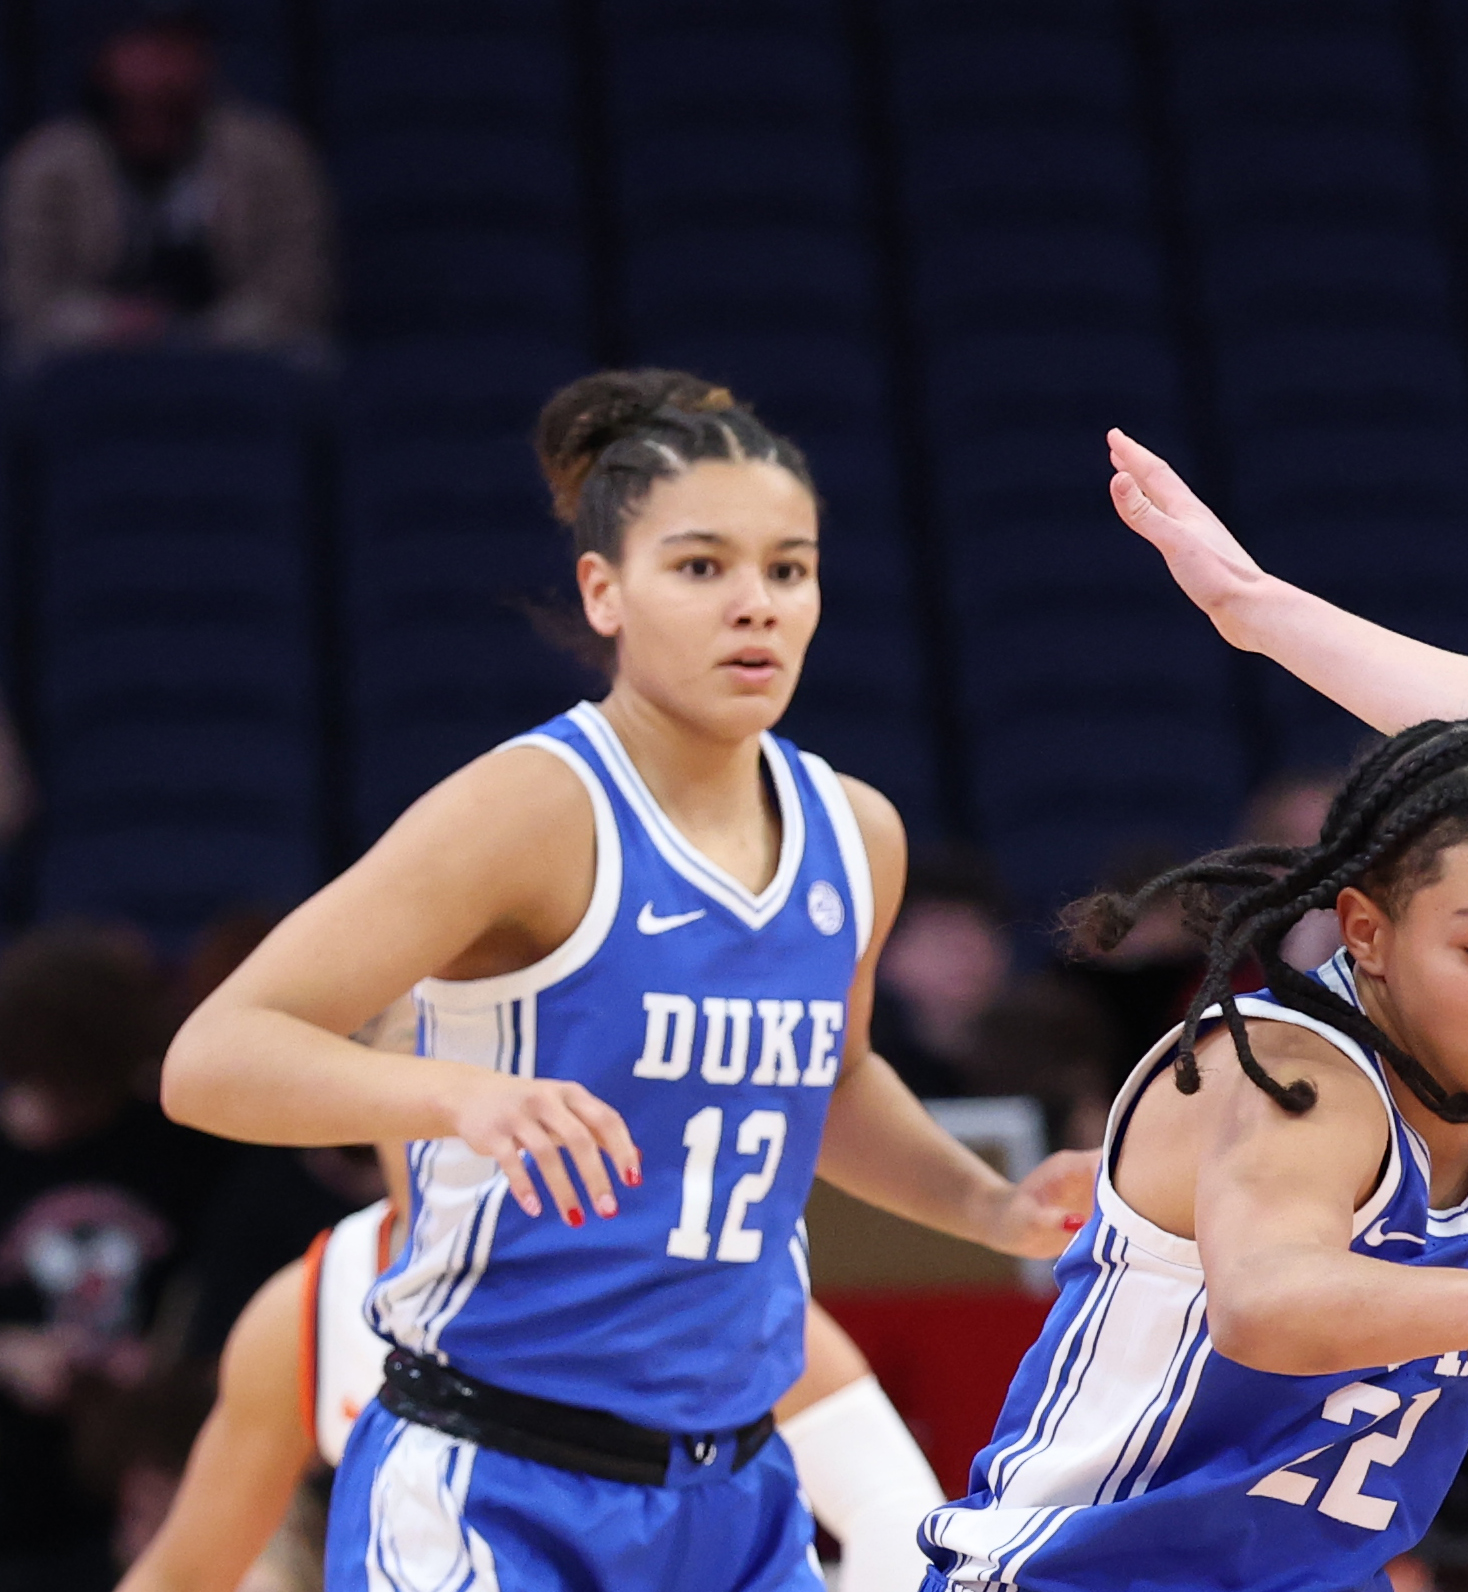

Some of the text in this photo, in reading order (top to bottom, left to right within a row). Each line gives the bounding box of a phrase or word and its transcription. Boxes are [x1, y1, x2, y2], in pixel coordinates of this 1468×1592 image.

[633, 991, 844, 1087] DUKE
[665, 1105, 788, 1263] 12
[1245, 1381, 1442, 1531] 22
